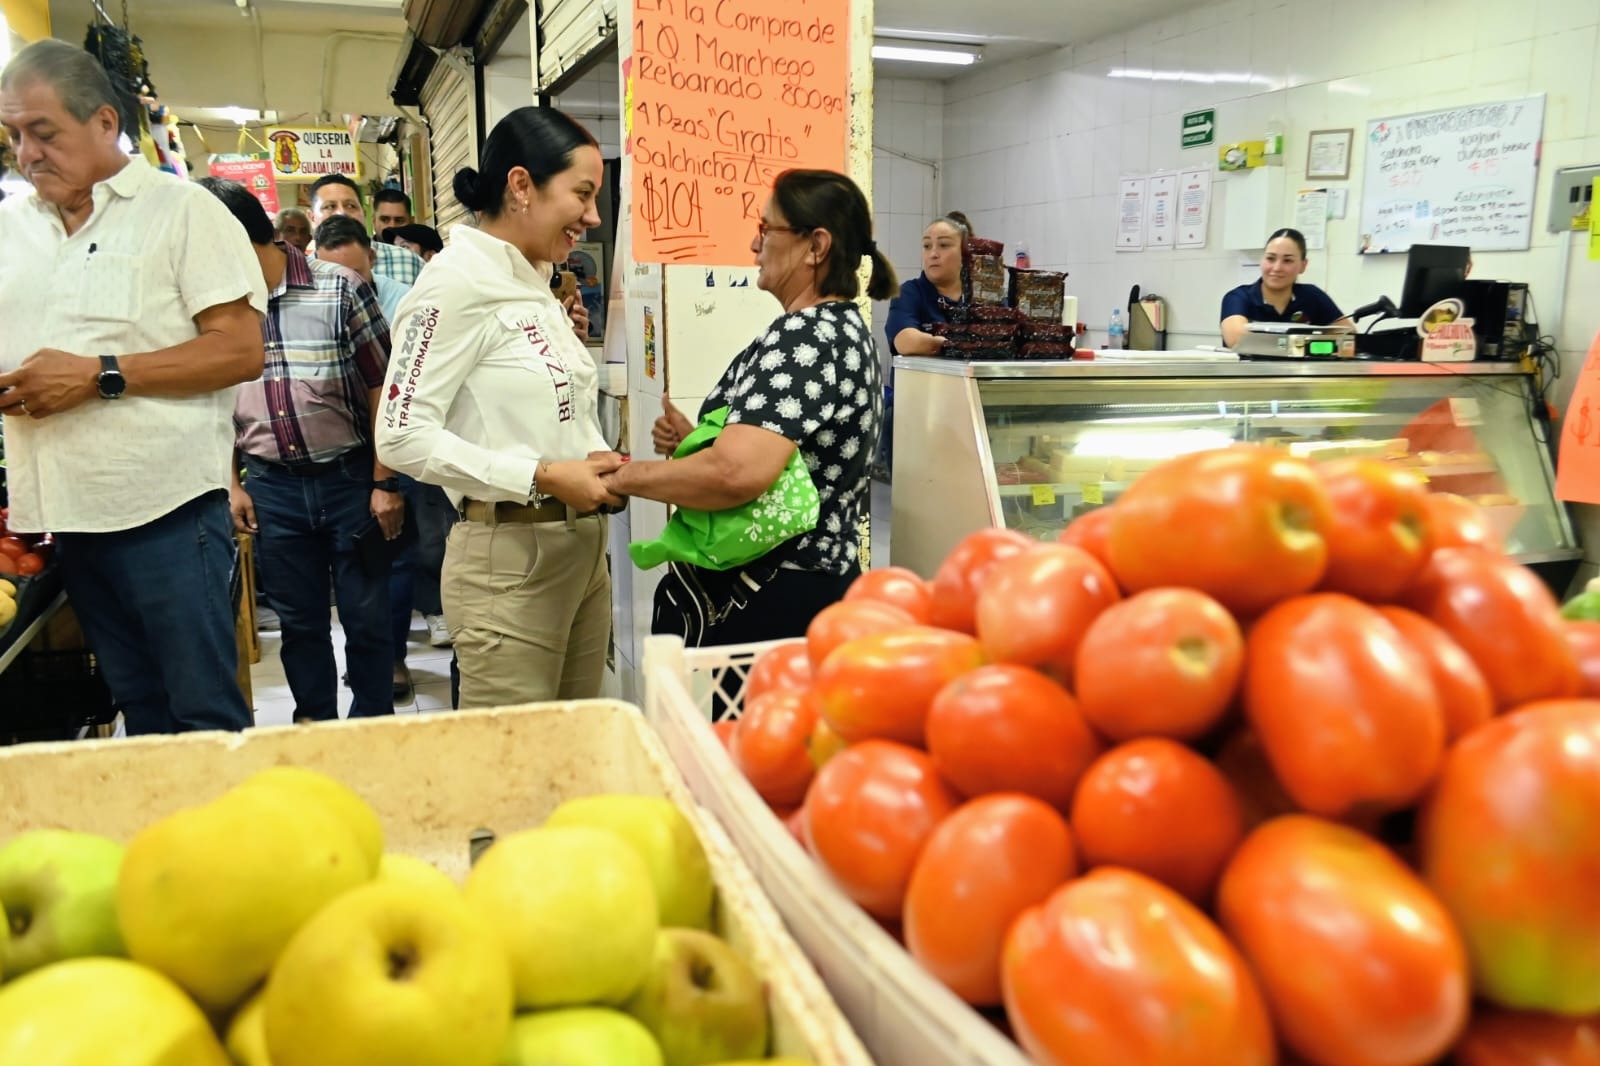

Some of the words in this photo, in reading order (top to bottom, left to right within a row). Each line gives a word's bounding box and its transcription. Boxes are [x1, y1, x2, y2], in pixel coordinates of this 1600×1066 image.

[715, 0, 802, 44] Compra
[808, 17, 835, 44] de
[639, 56, 762, 100] Rebanado
[696, 33, 815, 85] Manchego
[303, 132, 351, 145] QUESERIA
[320, 149, 332, 158] LA
[634, 137, 737, 183] Salchicha
[302, 162, 355, 174] GUADALUPANA
[399, 308, 440, 428] TRANSFORMACIÓN
